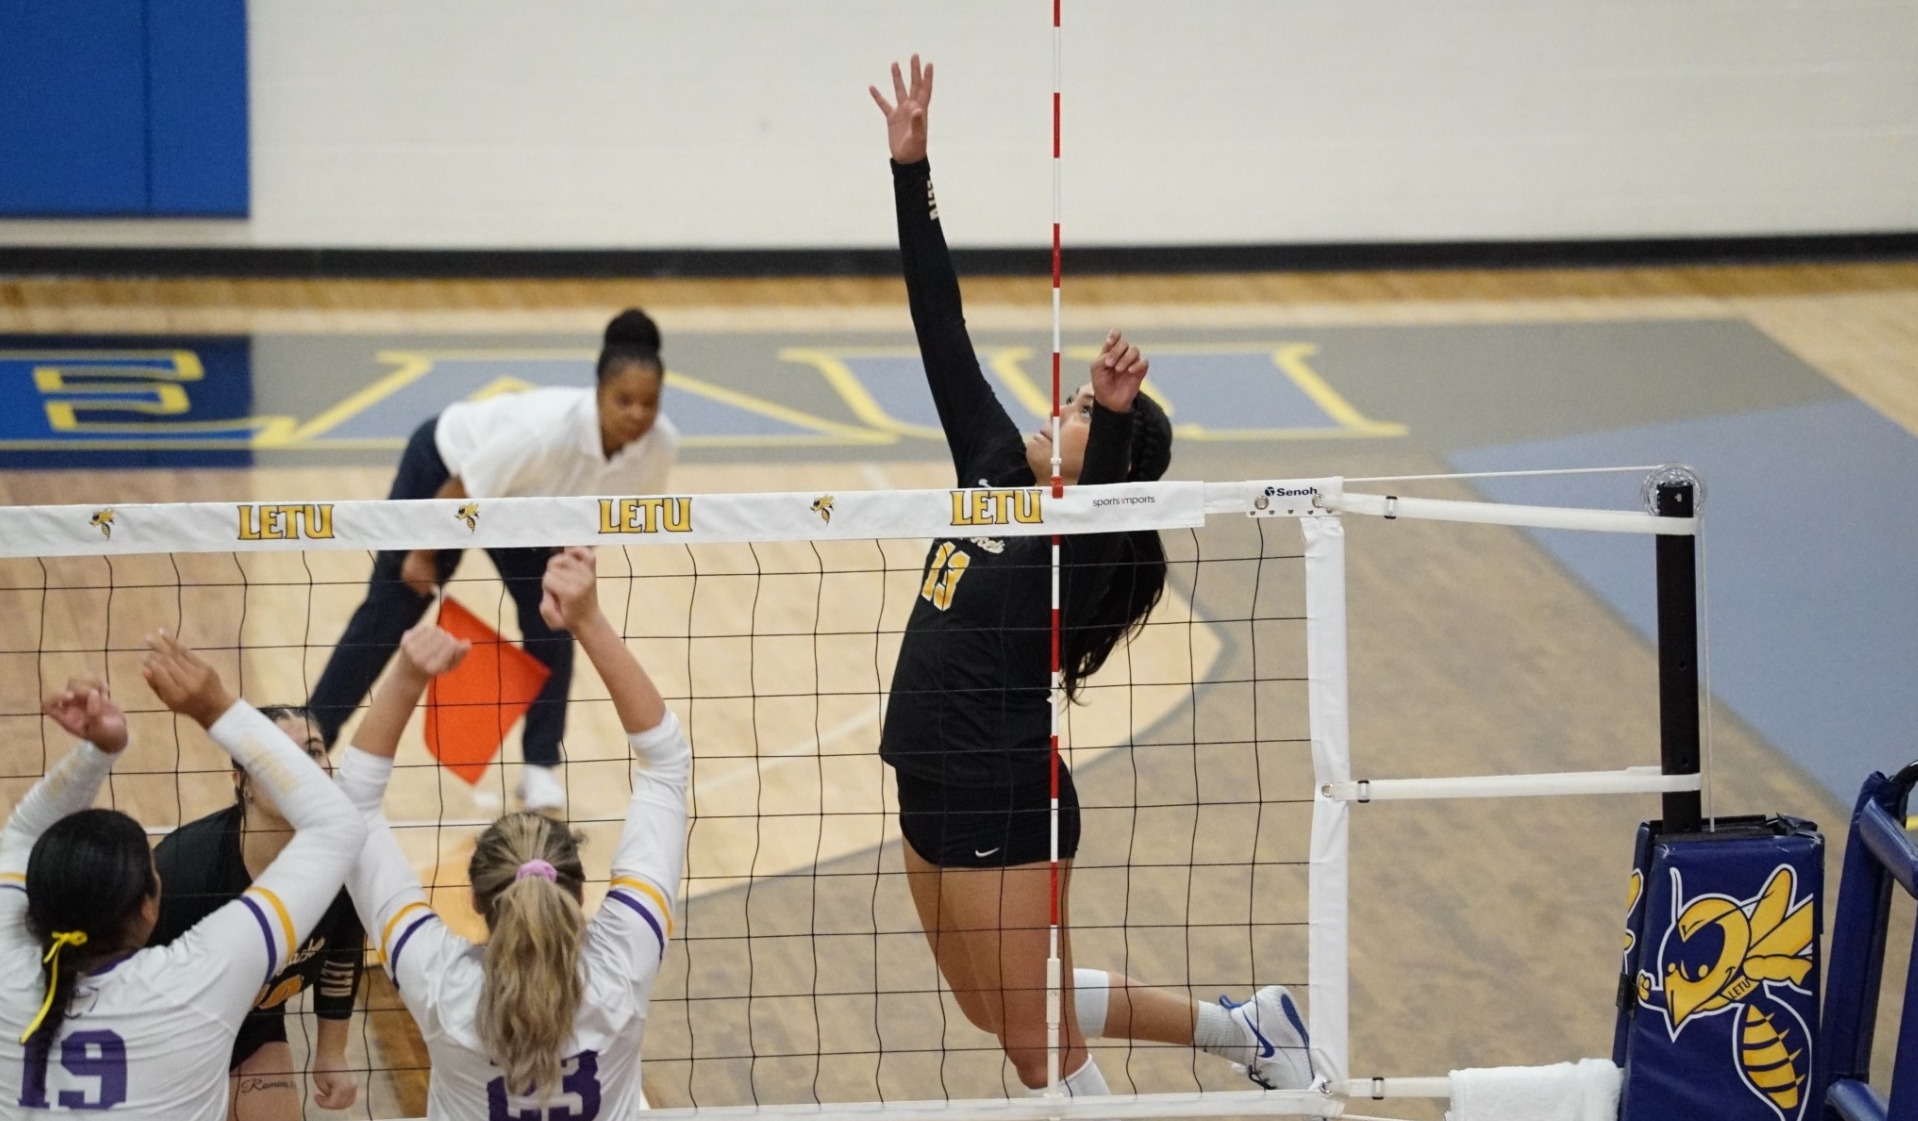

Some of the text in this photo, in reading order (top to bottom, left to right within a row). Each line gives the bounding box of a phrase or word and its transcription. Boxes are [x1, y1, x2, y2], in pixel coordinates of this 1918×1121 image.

[950, 489, 1044, 526] LETU
[1092, 497, 1121, 508] sports
[1276, 486, 1318, 497] Senoh
[237, 504, 335, 540] LETU
[598, 497, 693, 534] LETU
[921, 541, 971, 612] 13
[1728, 978, 1751, 999] LETU
[18, 1029, 127, 1110] 19
